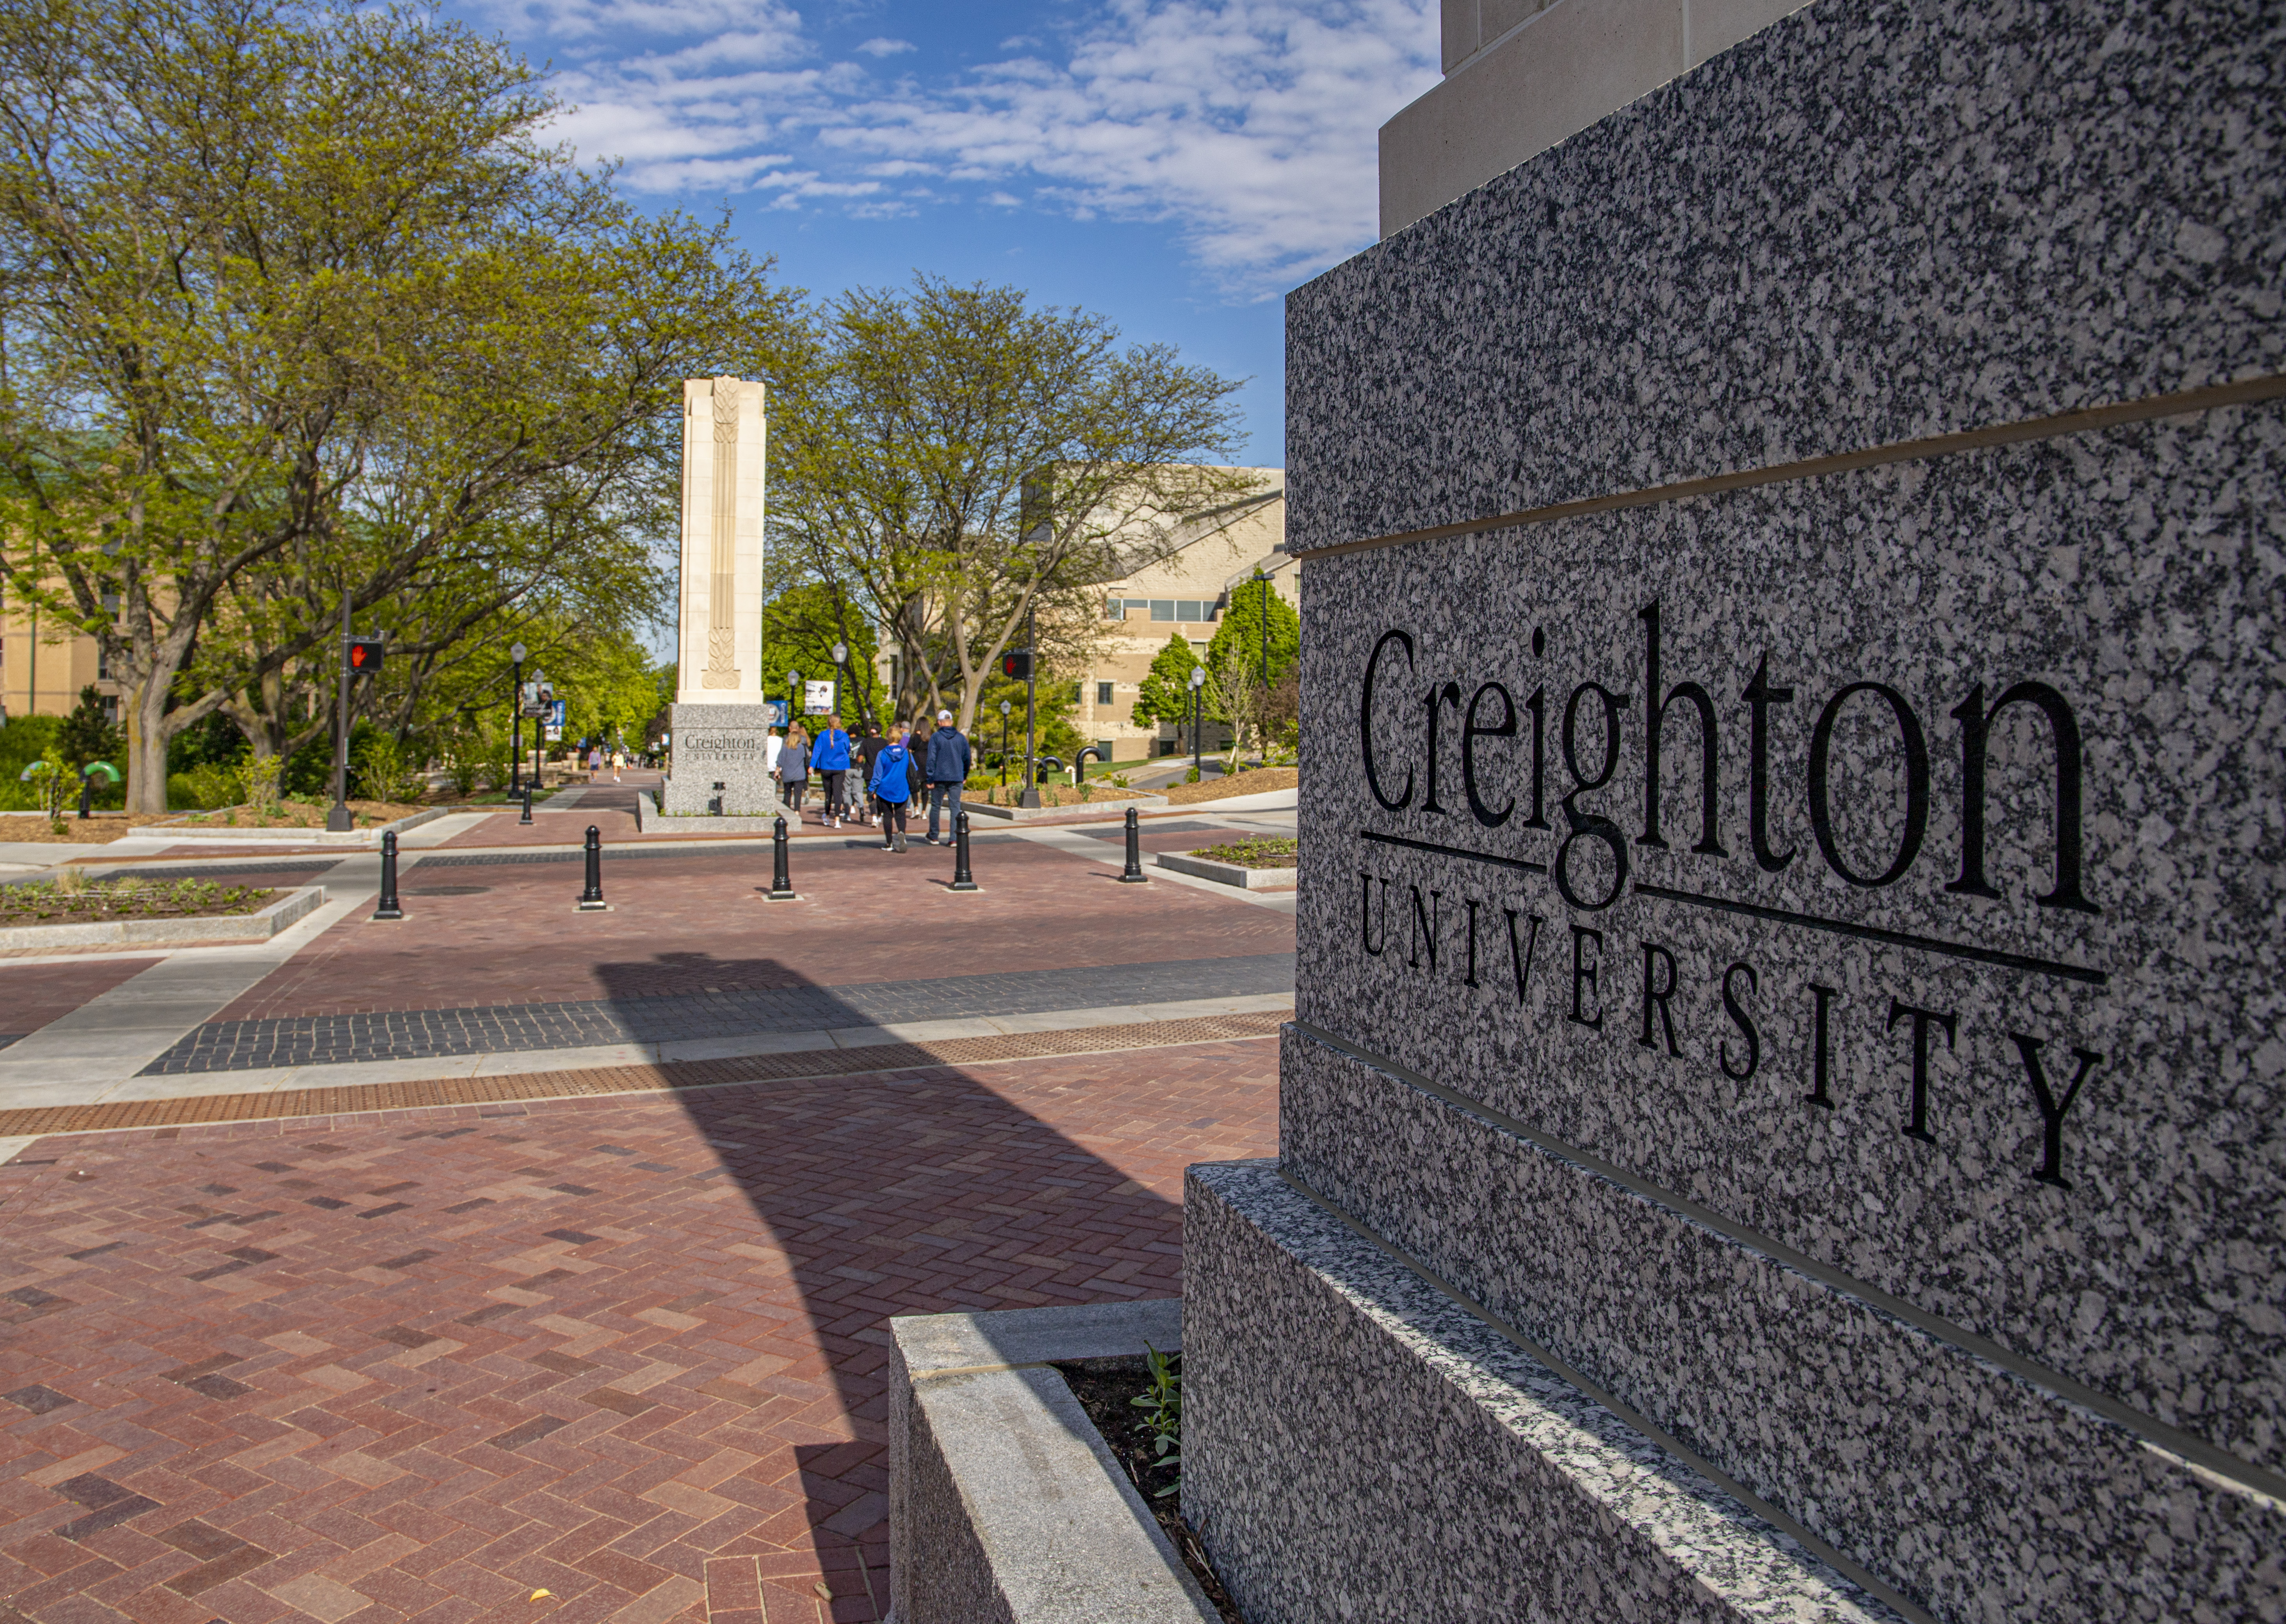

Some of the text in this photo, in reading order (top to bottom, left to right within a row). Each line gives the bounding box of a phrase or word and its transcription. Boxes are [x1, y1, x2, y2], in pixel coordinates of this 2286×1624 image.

[685, 734, 755, 753] Creighton
[1360, 598, 2101, 914] Creighton
[1360, 873, 2104, 1190] UNIVERSITY
